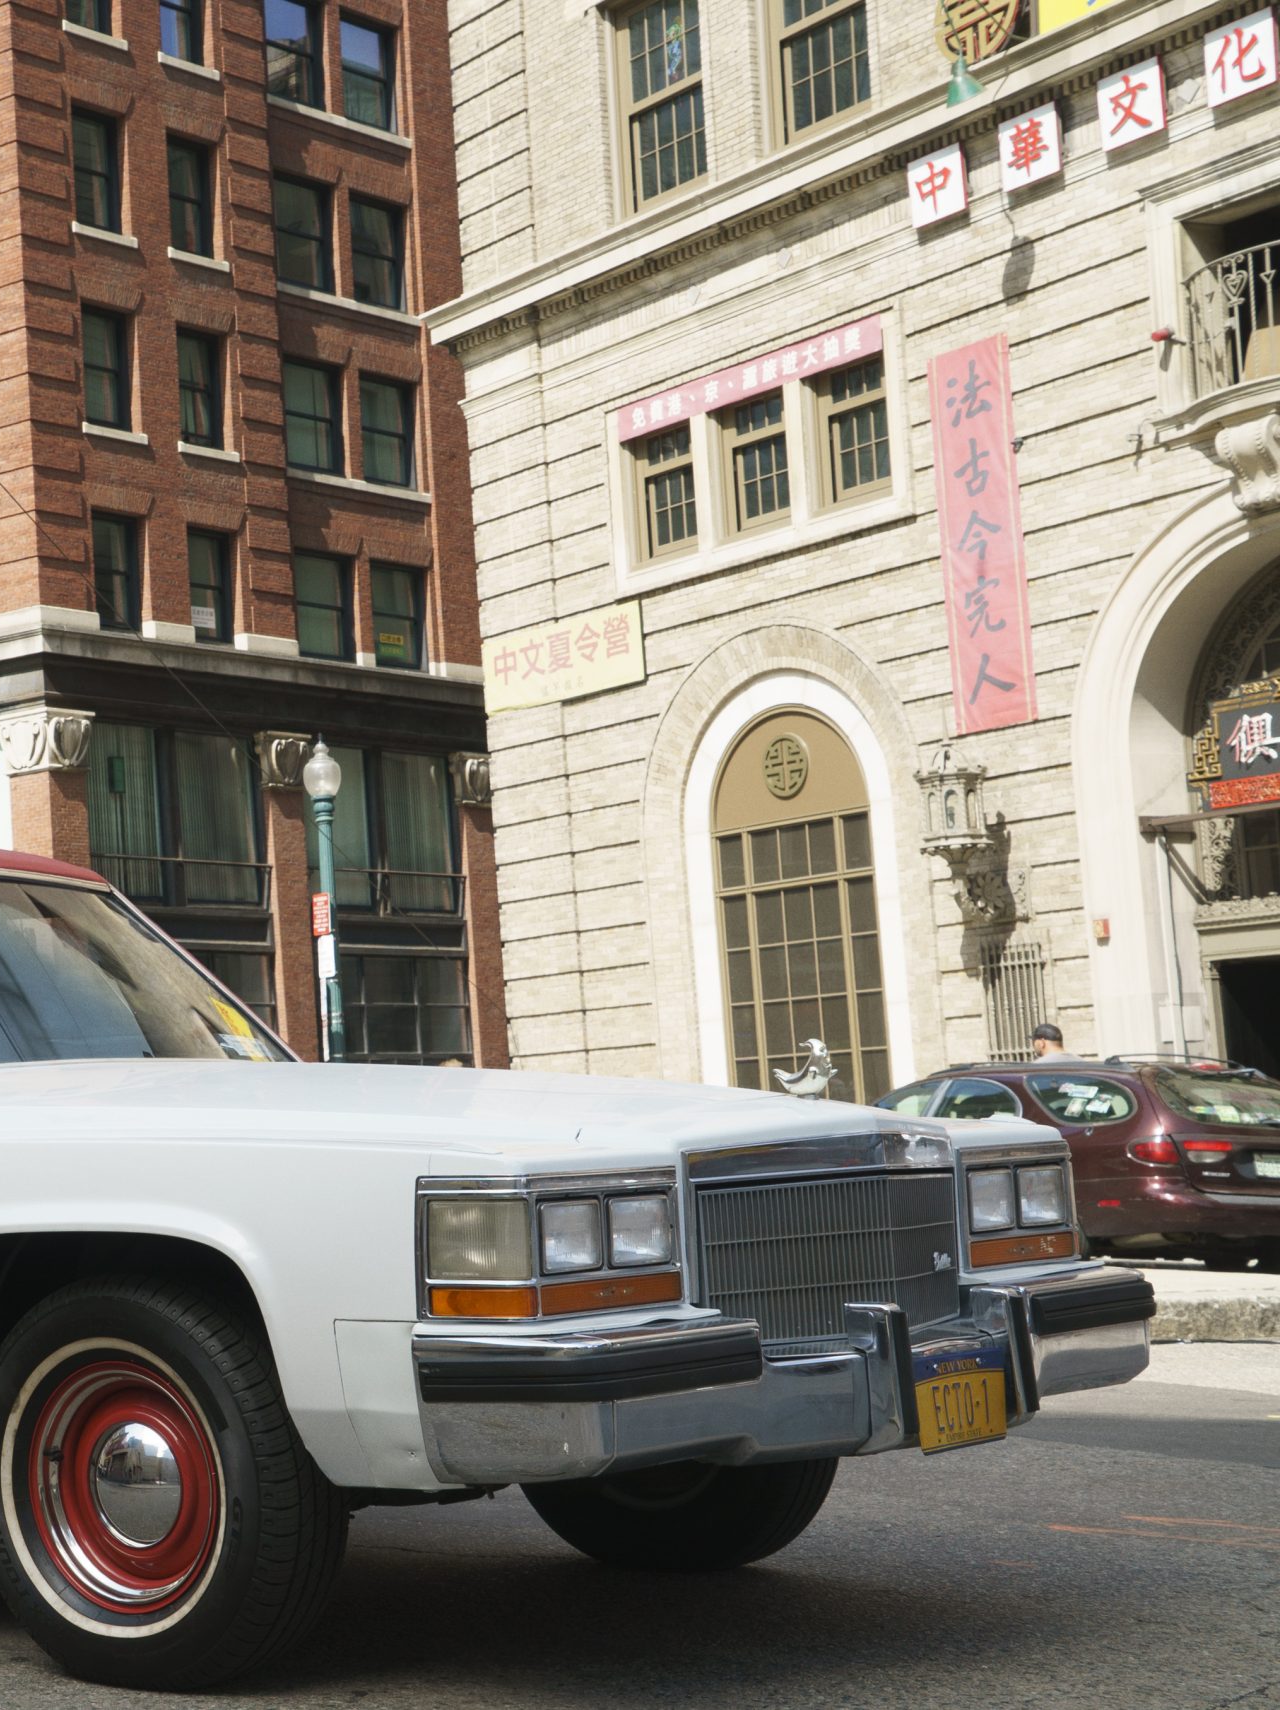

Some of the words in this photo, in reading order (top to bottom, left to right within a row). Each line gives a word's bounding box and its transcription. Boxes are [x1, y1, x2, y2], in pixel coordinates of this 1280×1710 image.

[915, 26, 1267, 214] 中華文化
[945, 359, 1017, 705] 法古今完人
[493, 613, 631, 686] 中文夏令營
[936, 1362, 957, 1374] NEW
[957, 1358, 978, 1370] YORK
[931, 1378, 990, 1433] ECTO-1
